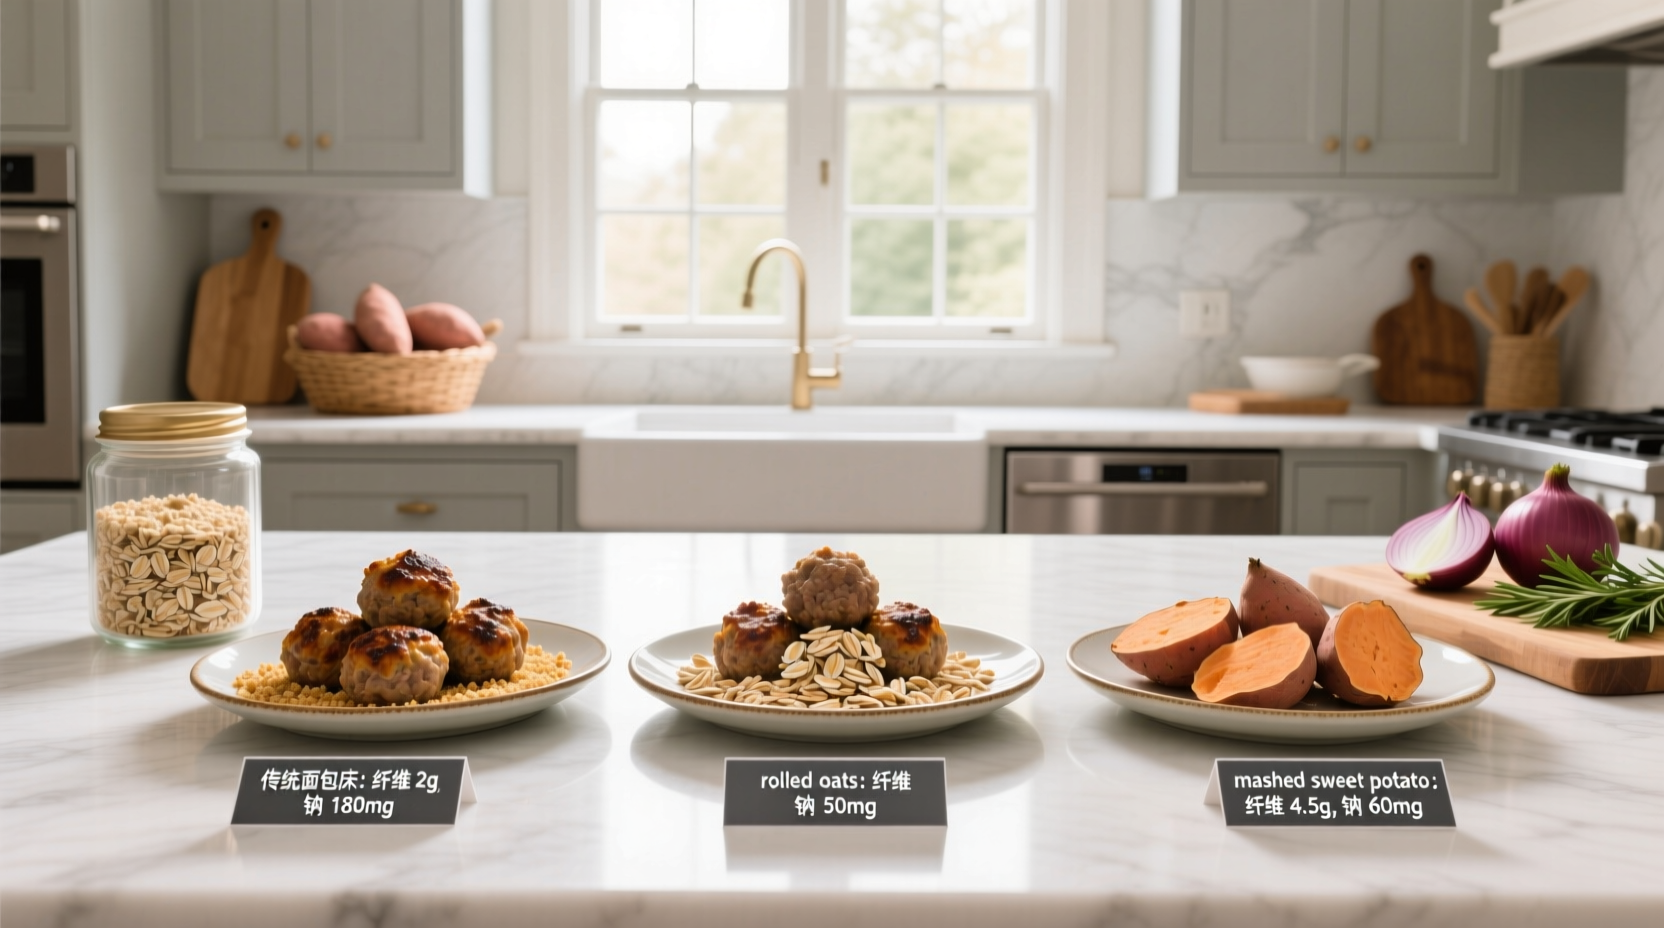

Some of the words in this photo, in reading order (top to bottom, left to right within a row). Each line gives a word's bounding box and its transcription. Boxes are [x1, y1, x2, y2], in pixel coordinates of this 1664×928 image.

[371, 769, 412, 791] 纤维
[415, 770, 441, 794] 2g,
[760, 770, 813, 790] rolled
[818, 772, 866, 790] oats:
[871, 769, 912, 792] 纤维
[1234, 770, 1306, 789] mashed
[1310, 772, 1365, 789] sweet
[1369, 771, 1438, 795] potato:
[303, 793, 324, 817] 钠
[331, 795, 395, 820] 180mg
[794, 793, 815, 817] 钠
[823, 796, 877, 820] 50mg
[1244, 794, 1285, 816] 纤维
[1289, 796, 1337, 820] 4.5g,
[1341, 794, 1363, 817] 钠
[1368, 795, 1424, 820] 60mg
